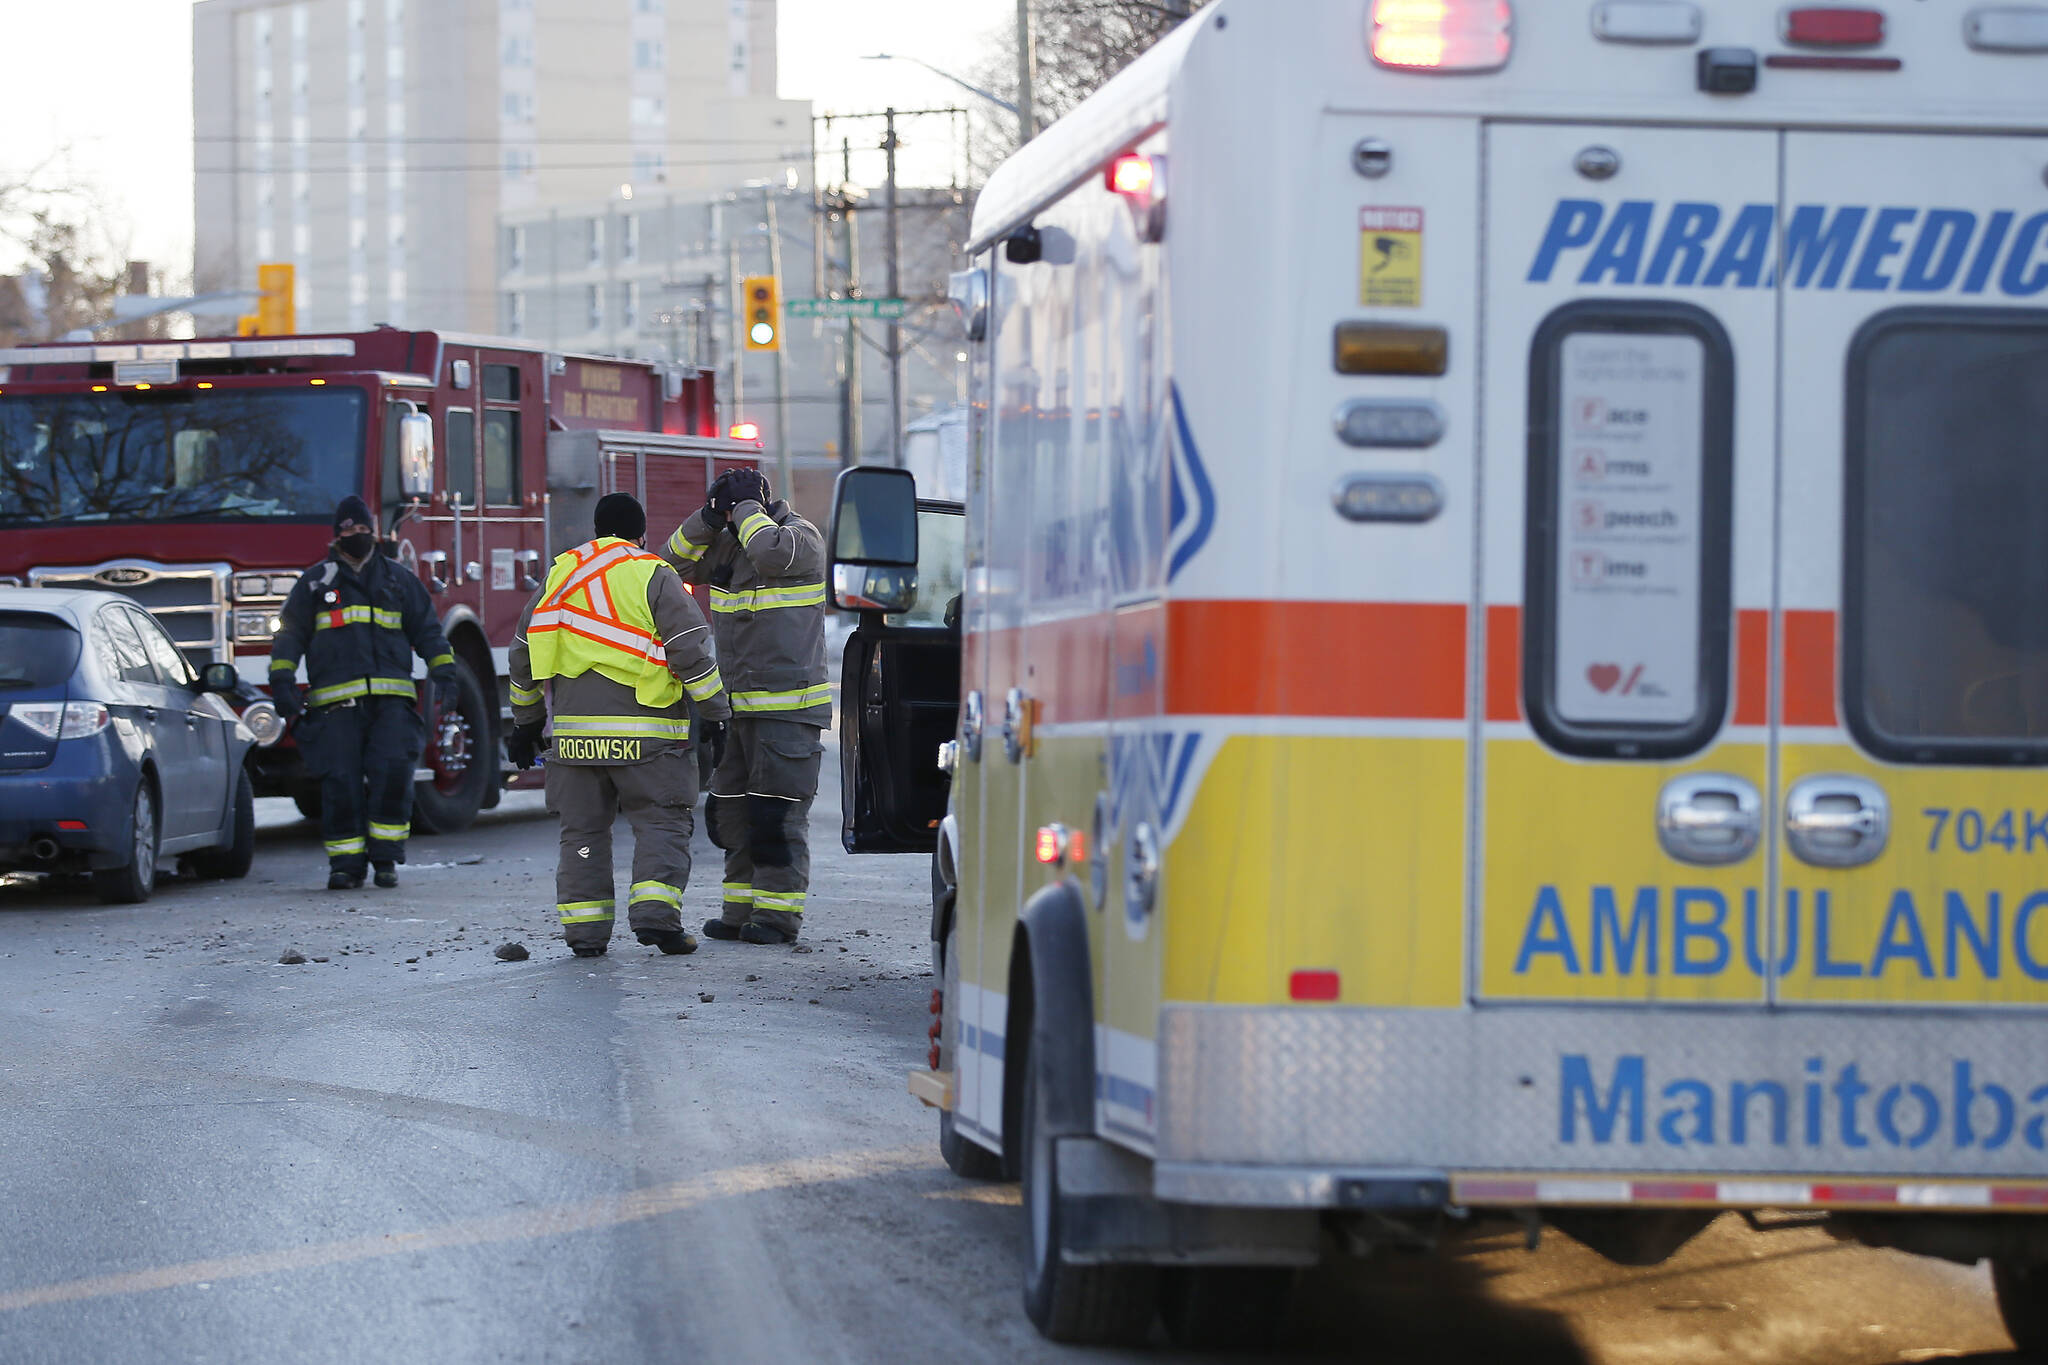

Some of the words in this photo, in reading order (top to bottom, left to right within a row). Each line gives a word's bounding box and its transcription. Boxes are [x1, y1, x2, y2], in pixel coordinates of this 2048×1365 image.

[1527, 199, 2048, 298] PARAMEDIC
[559, 738, 641, 760] ROGOWSKI
[1922, 808, 2048, 853] 704K
